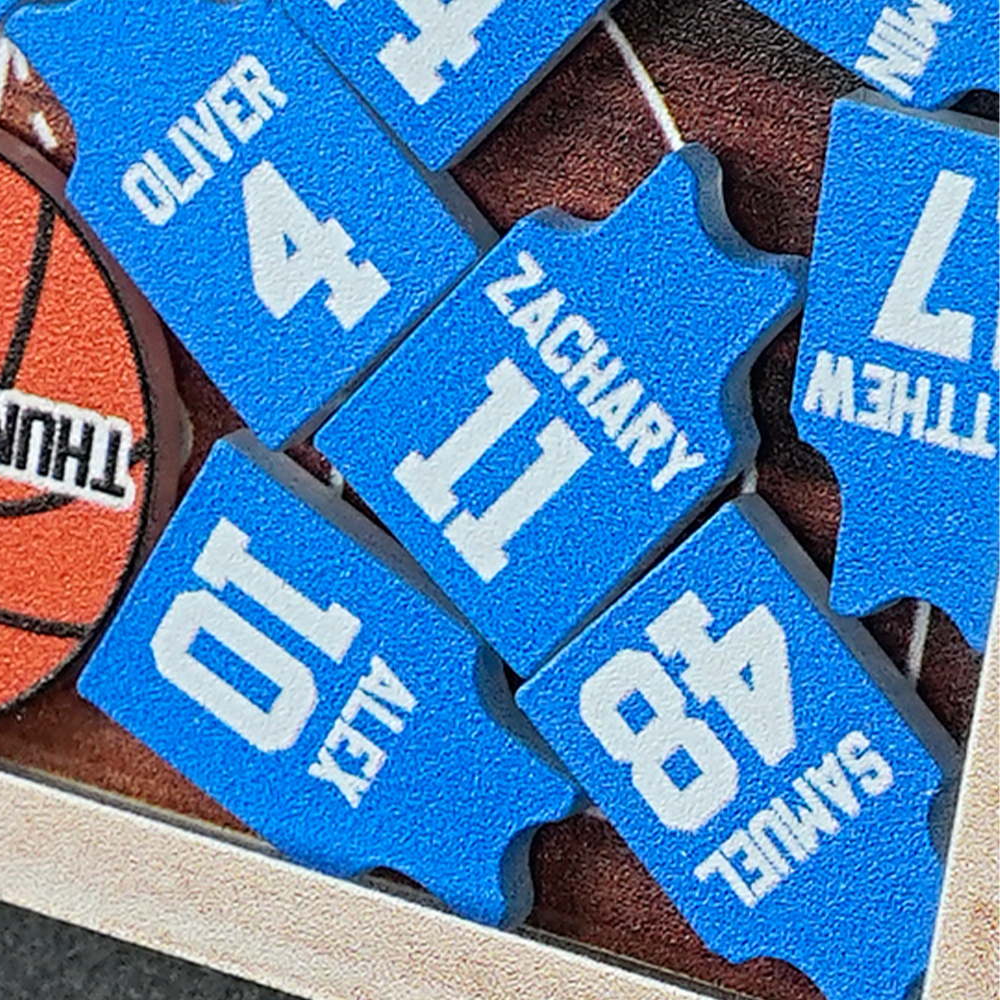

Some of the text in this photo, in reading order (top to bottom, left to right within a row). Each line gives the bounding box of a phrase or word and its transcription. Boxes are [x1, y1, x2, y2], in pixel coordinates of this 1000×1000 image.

[123, 56, 286, 225] OLIVER
[243, 161, 390, 328] 4
[873, 171, 1000, 371] 7
[488, 252, 705, 490] ZACHARY
[804, 352, 996, 458] TTHEW
[394, 358, 591, 579] 11
[152, 518, 361, 752] 10
[581, 591, 796, 830] 48
[310, 656, 414, 807] ALEX
[695, 731, 892, 905] SAMUEL
